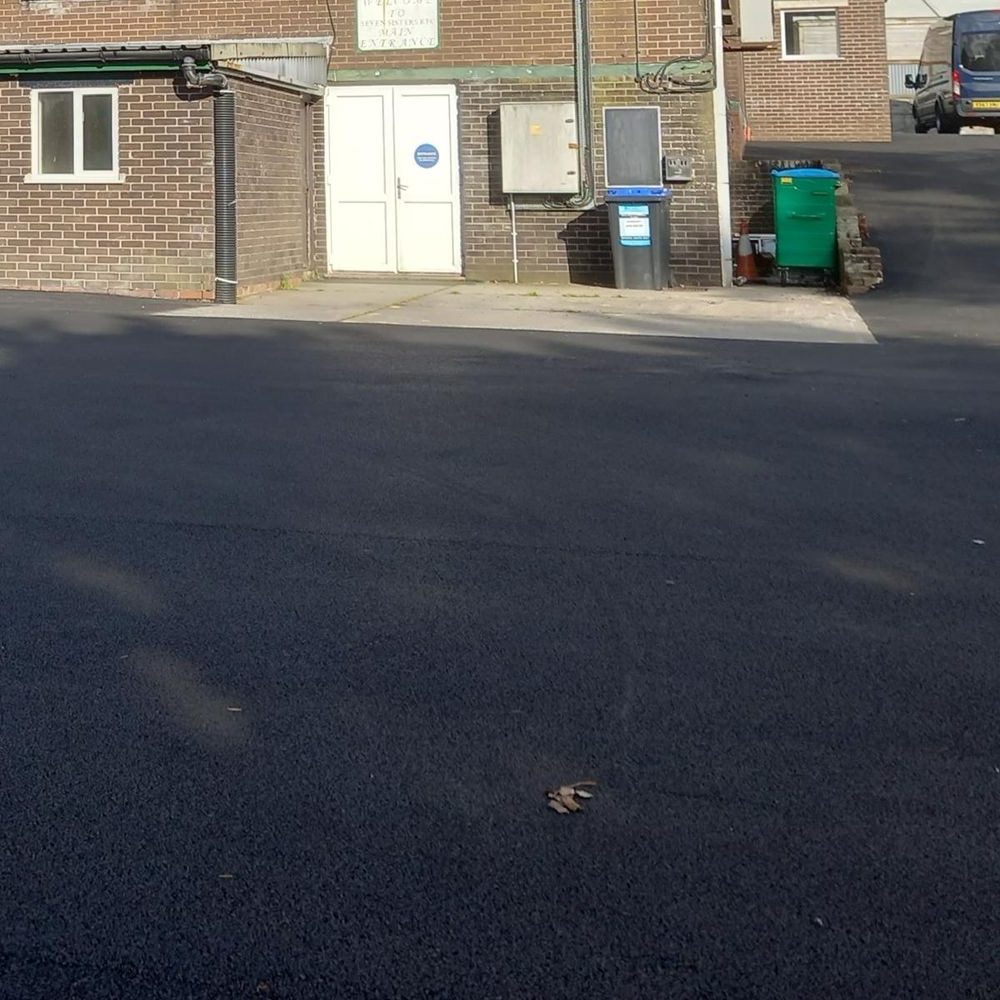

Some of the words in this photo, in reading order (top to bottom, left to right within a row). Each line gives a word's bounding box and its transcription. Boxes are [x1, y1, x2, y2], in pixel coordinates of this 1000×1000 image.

[390, 9, 405, 18] TO
[379, 27, 413, 37] MAIN
[360, 38, 436, 48] ENTRANCE
